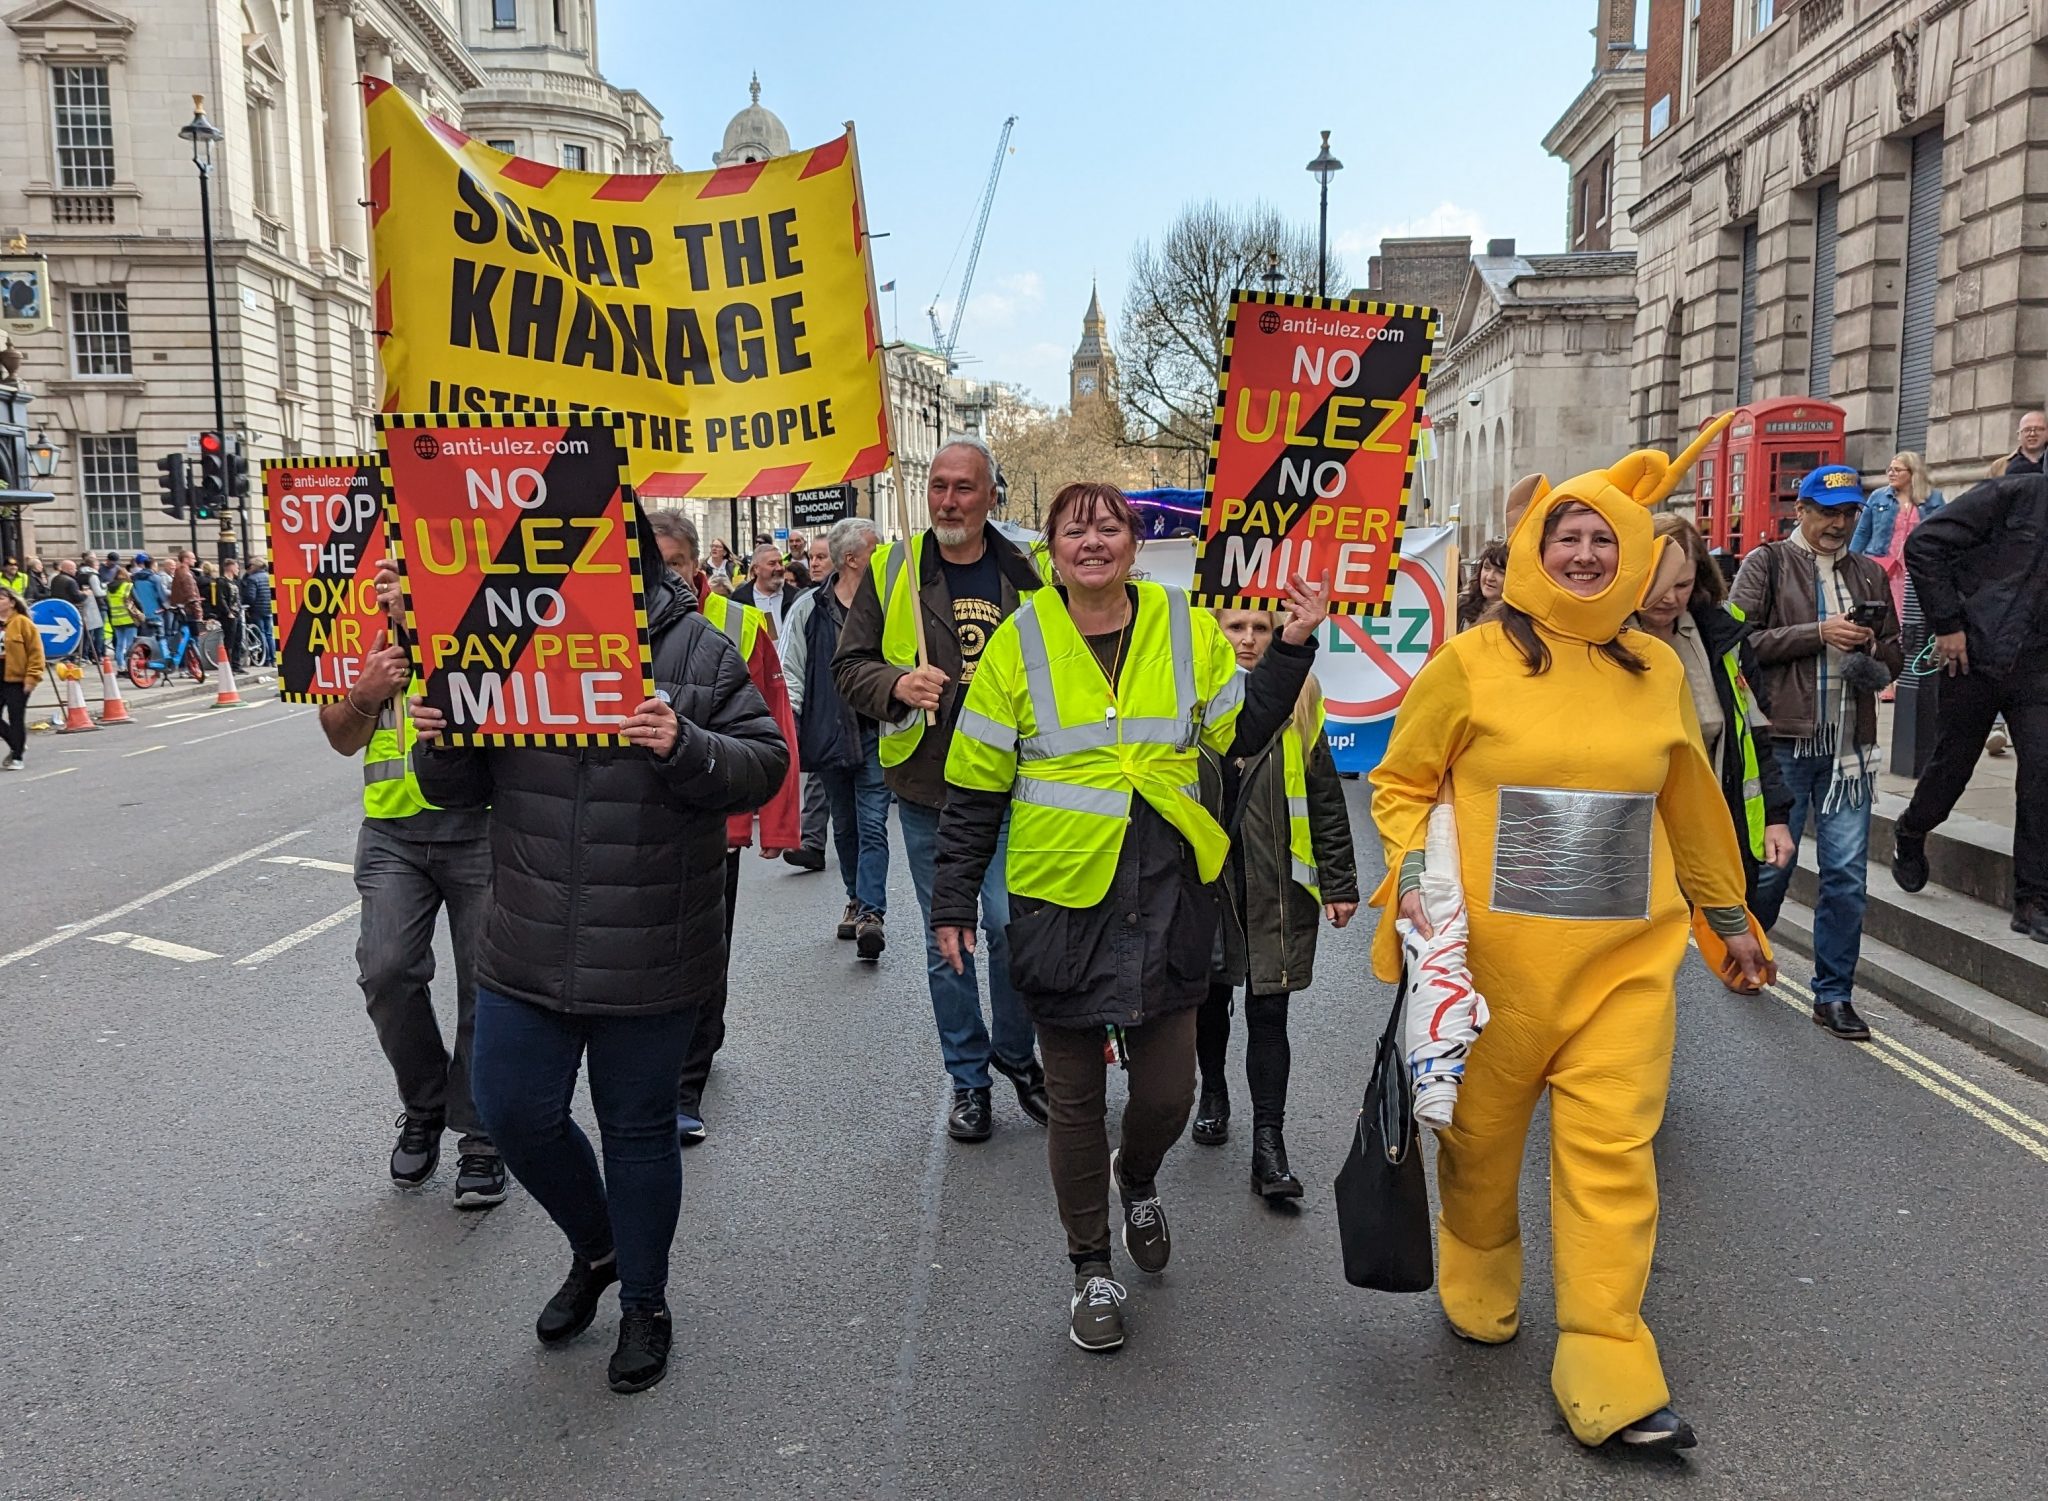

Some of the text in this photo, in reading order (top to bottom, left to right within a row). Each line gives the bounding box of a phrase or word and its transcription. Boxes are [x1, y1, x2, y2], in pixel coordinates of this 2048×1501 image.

[453, 167, 804, 292] SCRAP THE
[449, 257, 812, 387] KHANAGE
[1282, 317, 1404, 343] anti-ulez.com
[1291, 345, 1361, 388] NO
[627, 411, 694, 453] THE
[706, 398, 836, 453] PEOPLE
[1235, 387, 1406, 453] ULEZ
[1770, 421, 1830, 433] TELEPHONE
[442, 437, 589, 456] anti-ulez.com
[294, 474, 368, 488] anti-ulez.com
[465, 467, 548, 510] NO
[797, 489, 841, 501] TAKE BACK
[1277, 457, 1347, 499] NO
[281, 493, 376, 534] STOP
[795, 501, 844, 514] DEMOCRACY
[1219, 498, 1390, 542] PAY PER
[299, 543, 357, 574] THE
[414, 517, 622, 575] ULEZ
[1221, 535, 1376, 594] MILE
[281, 578, 379, 616] TOXIC
[485, 587, 566, 627] NO
[308, 617, 363, 655] AIR
[1311, 608, 1431, 653] LEZ
[431, 633, 633, 669] PAY PER
[314, 655, 360, 689] LIE
[447, 671, 628, 725] MILE
[1328, 732, 1356, 750] up!
